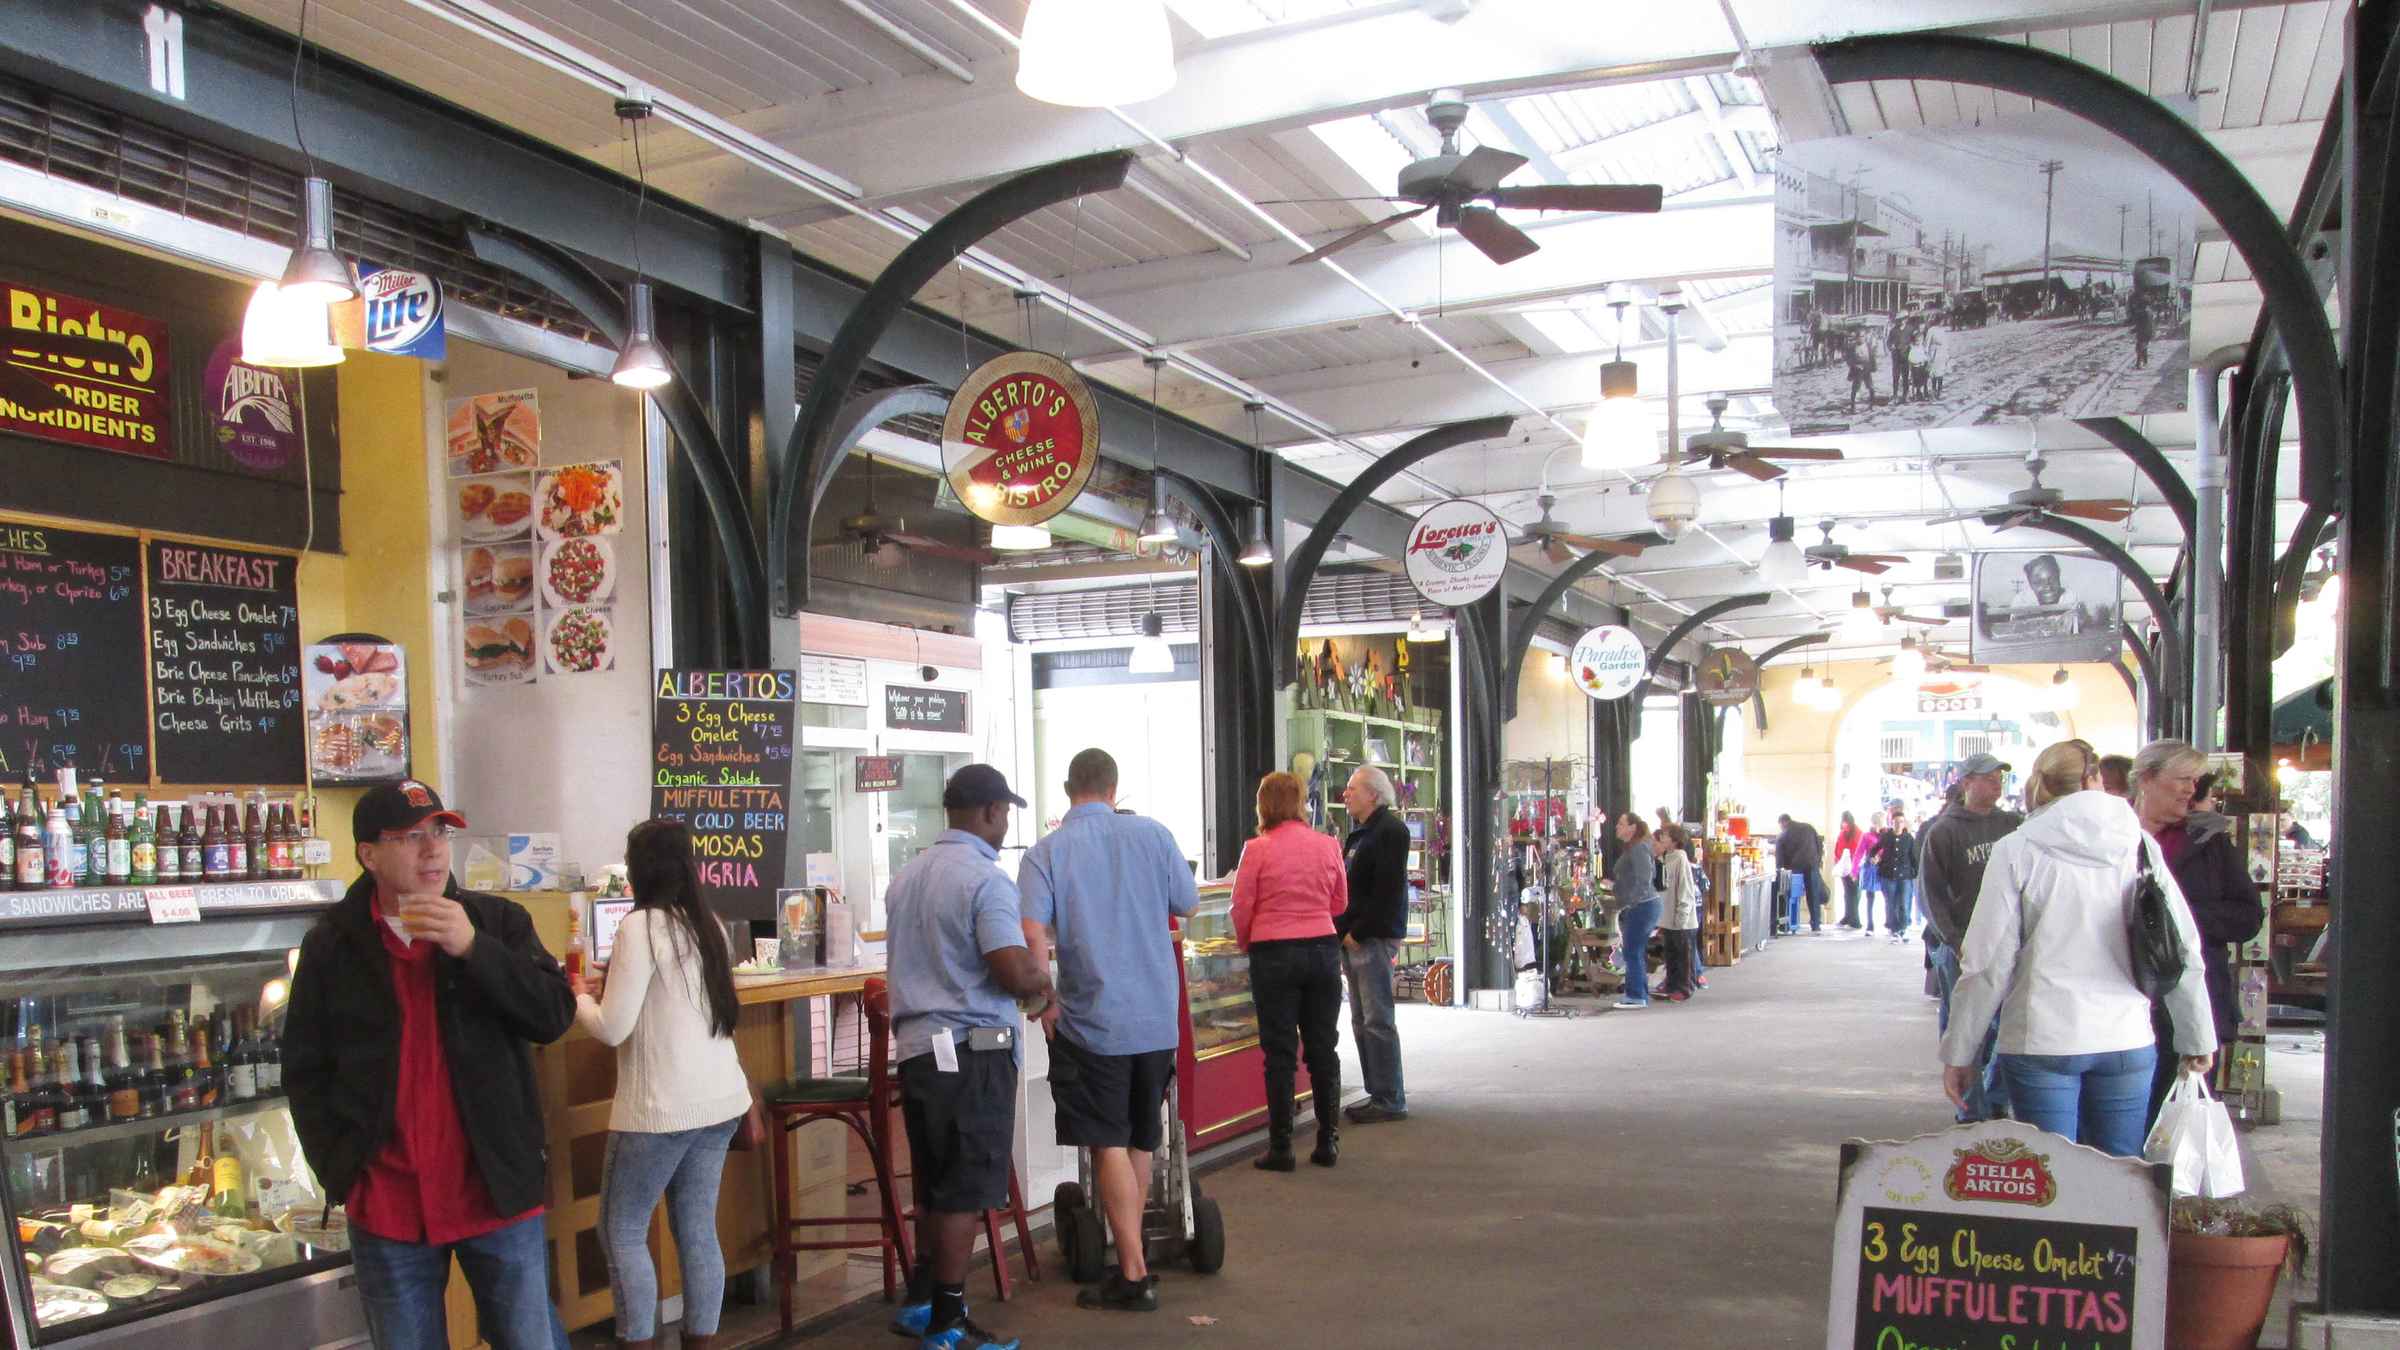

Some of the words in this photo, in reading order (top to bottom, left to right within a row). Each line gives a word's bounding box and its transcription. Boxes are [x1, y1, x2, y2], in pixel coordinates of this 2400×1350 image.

[373, 272, 416, 292] Miller
[367, 289, 429, 345] Lite
[222, 365, 288, 414] ABITA
[966, 380, 1066, 444] ALBERTO'S
[995, 438, 1055, 468] CHEESE
[1002, 469, 1012, 480] &
[1016, 453, 1055, 474] WINE
[996, 462, 1072, 506] BISTRO
[1408, 521, 1497, 555] Loretta's
[161, 548, 279, 590] BREAKFAST
[151, 597, 162, 620] 3
[165, 599, 189, 628] Egg
[191, 600, 232, 622] Cheese
[238, 603, 278, 624] Omelet
[17, 632, 47, 651] Sub
[153, 630, 179, 657] Egg
[185, 629, 256, 653] Sandwiches
[1575, 645, 1639, 663] Paradise
[156, 661, 185, 680] Brie
[189, 661, 229, 685] Cheese
[232, 661, 280, 687] Pancakes
[1600, 661, 1641, 670] Garden
[157, 687, 186, 706] Brie
[237, 687, 281, 710] Waffles
[658, 672, 794, 699] ALBERTOS
[159, 712, 209, 735] Cheese
[219, 714, 252, 734] Grits
[676, 702, 691, 722] 3
[697, 702, 721, 728] Egg
[728, 702, 776, 726] Cheese
[691, 726, 739, 744] Omelet
[657, 743, 684, 767] Egg
[690, 743, 761, 766] Sandwiches
[657, 768, 709, 788] Organic
[719, 766, 761, 786] Salads
[663, 789, 783, 809] MUFFULETTA
[694, 813, 735, 830] COLD
[744, 812, 785, 831] BEER
[692, 834, 764, 858] MOSAS
[698, 861, 759, 888] NGRIA
[10, 893, 112, 915] SANDWICHES
[200, 888, 243, 905] FRESH
[249, 886, 265, 901] TO
[1966, 1163, 2036, 1180] STELLA
[1964, 1178, 2036, 1196] ARTOIS
[1864, 1222, 1889, 1262] 3
[1900, 1222, 1941, 1274] Egg
[1951, 1229, 2025, 1276] Cheese
[2033, 1238, 2105, 1281] Omelet
[1872, 1272, 2130, 1334] MUFFULETTAS
